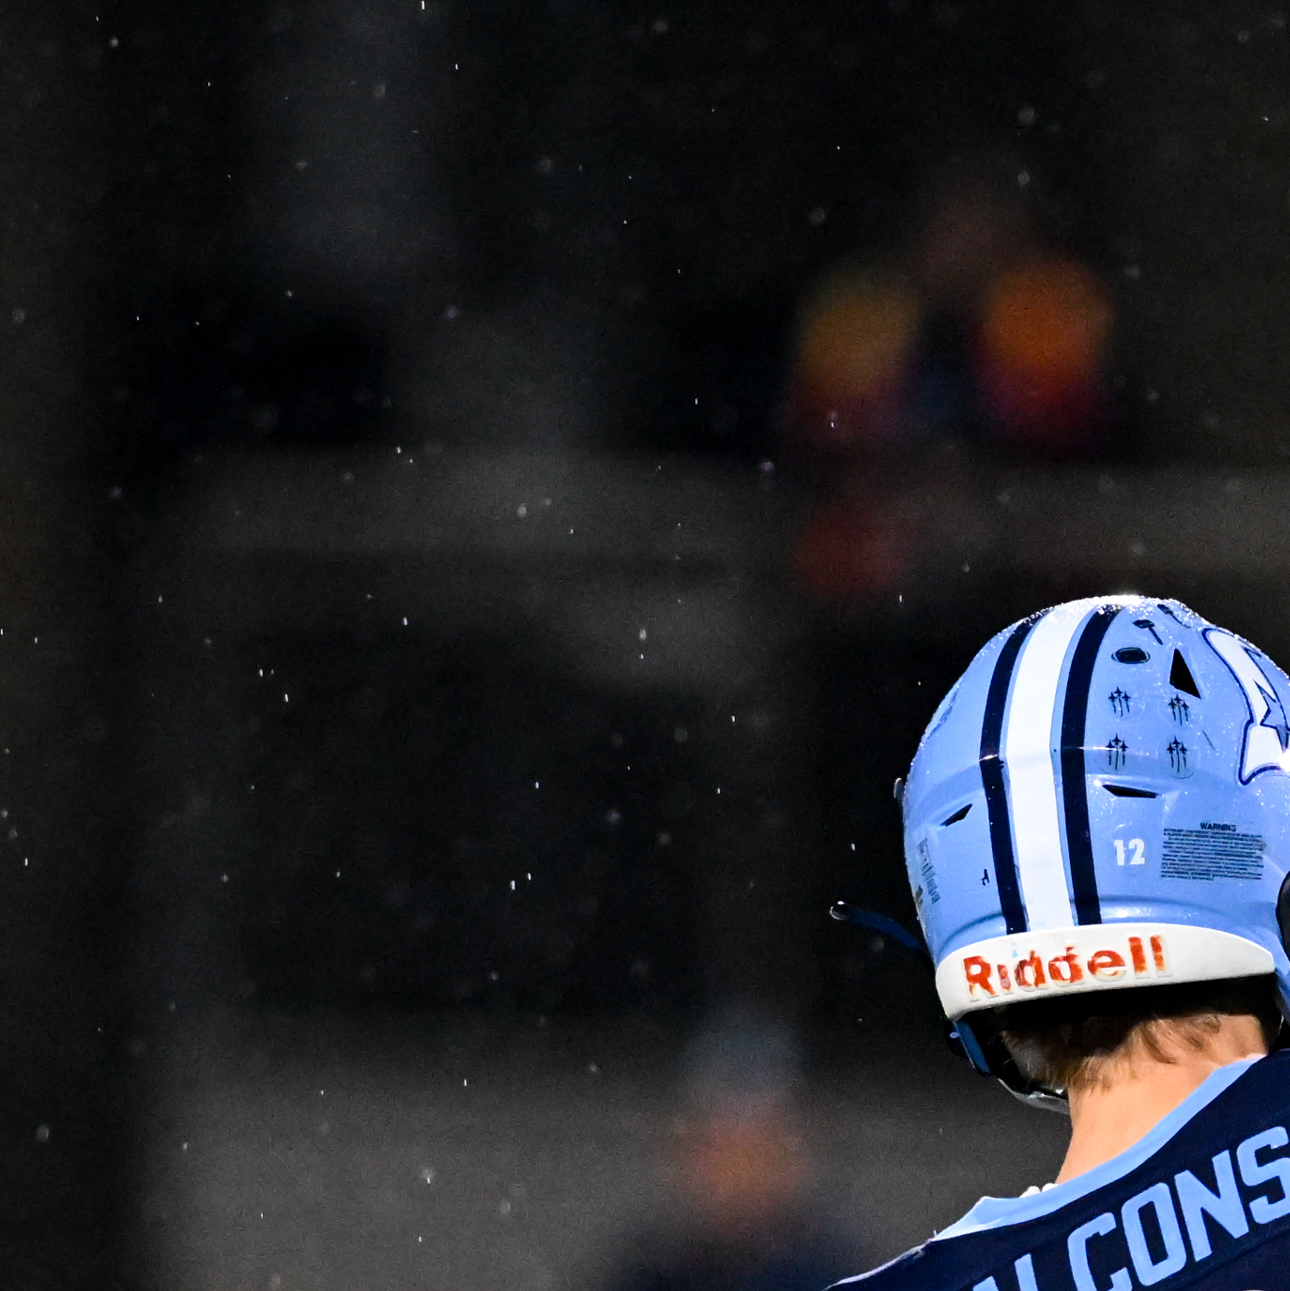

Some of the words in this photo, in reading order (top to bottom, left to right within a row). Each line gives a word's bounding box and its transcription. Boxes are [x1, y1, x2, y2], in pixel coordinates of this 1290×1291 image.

[1200, 822, 1237, 832] WARNING
[1114, 838, 1145, 866] 12
[963, 934, 1173, 1002] Riddell
